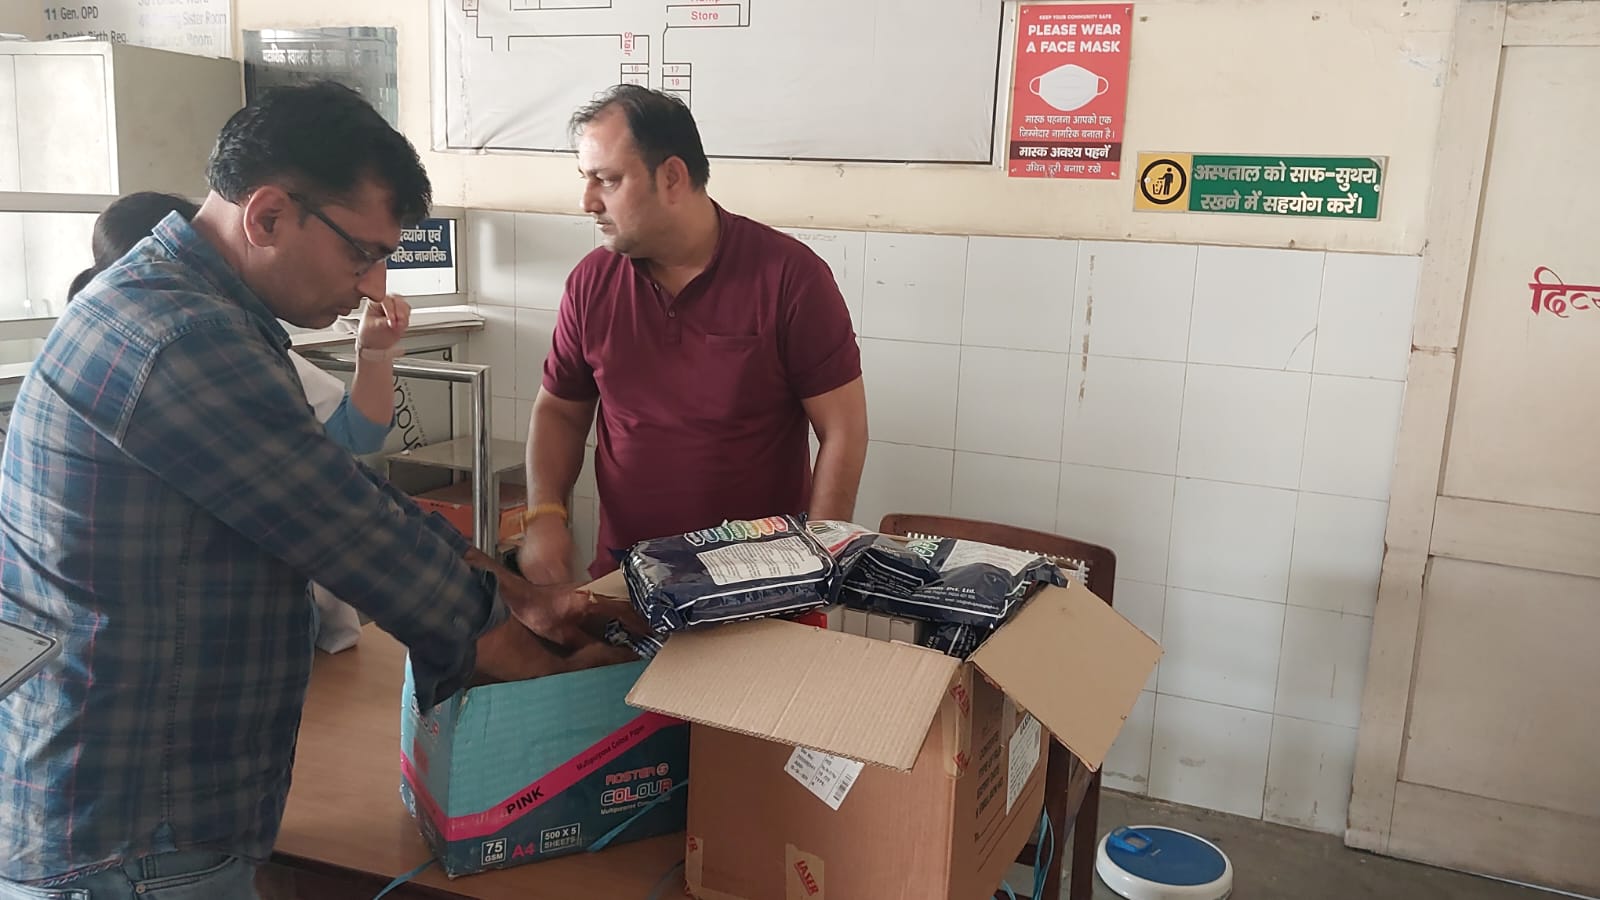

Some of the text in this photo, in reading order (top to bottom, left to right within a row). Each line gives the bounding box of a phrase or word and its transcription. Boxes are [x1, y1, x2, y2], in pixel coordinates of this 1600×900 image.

[44, 6, 99, 20] 11 Gen. OPD
[691, 10, 719, 21] Store
[1028, 23, 1121, 36] PLEASE WEAR
[624, 31, 633, 57] Stair
[1025, 40, 1121, 53] A FACE MASK
[670, 65, 680, 73] 17
[671, 78, 680, 86] 19
[1024, 115, 1045, 124] मास्क
[1099, 115, 1112, 125] एक
[1019, 144, 1112, 159] मास्क अवश्य पहनें
[1194, 164, 1262, 182] अस्पताल
[1263, 161, 1287, 182] को
[1200, 189, 1242, 211] रखने
[1243, 190, 1263, 211] में
[1263, 191, 1324, 214] सहयोग
[400, 225, 443, 243] व्यांग एवं
[391, 246, 447, 263] वरिष्ठ नागरिक
[600, 778, 673, 807] COLOUR
[506, 785, 545, 815] PINK
[544, 830, 561, 841] 500
[571, 827, 577, 835] 5
[485, 841, 503, 855] 75
[544, 837, 577, 849] SHEETS
[484, 853, 504, 862] GSM
[512, 842, 536, 859] A4
